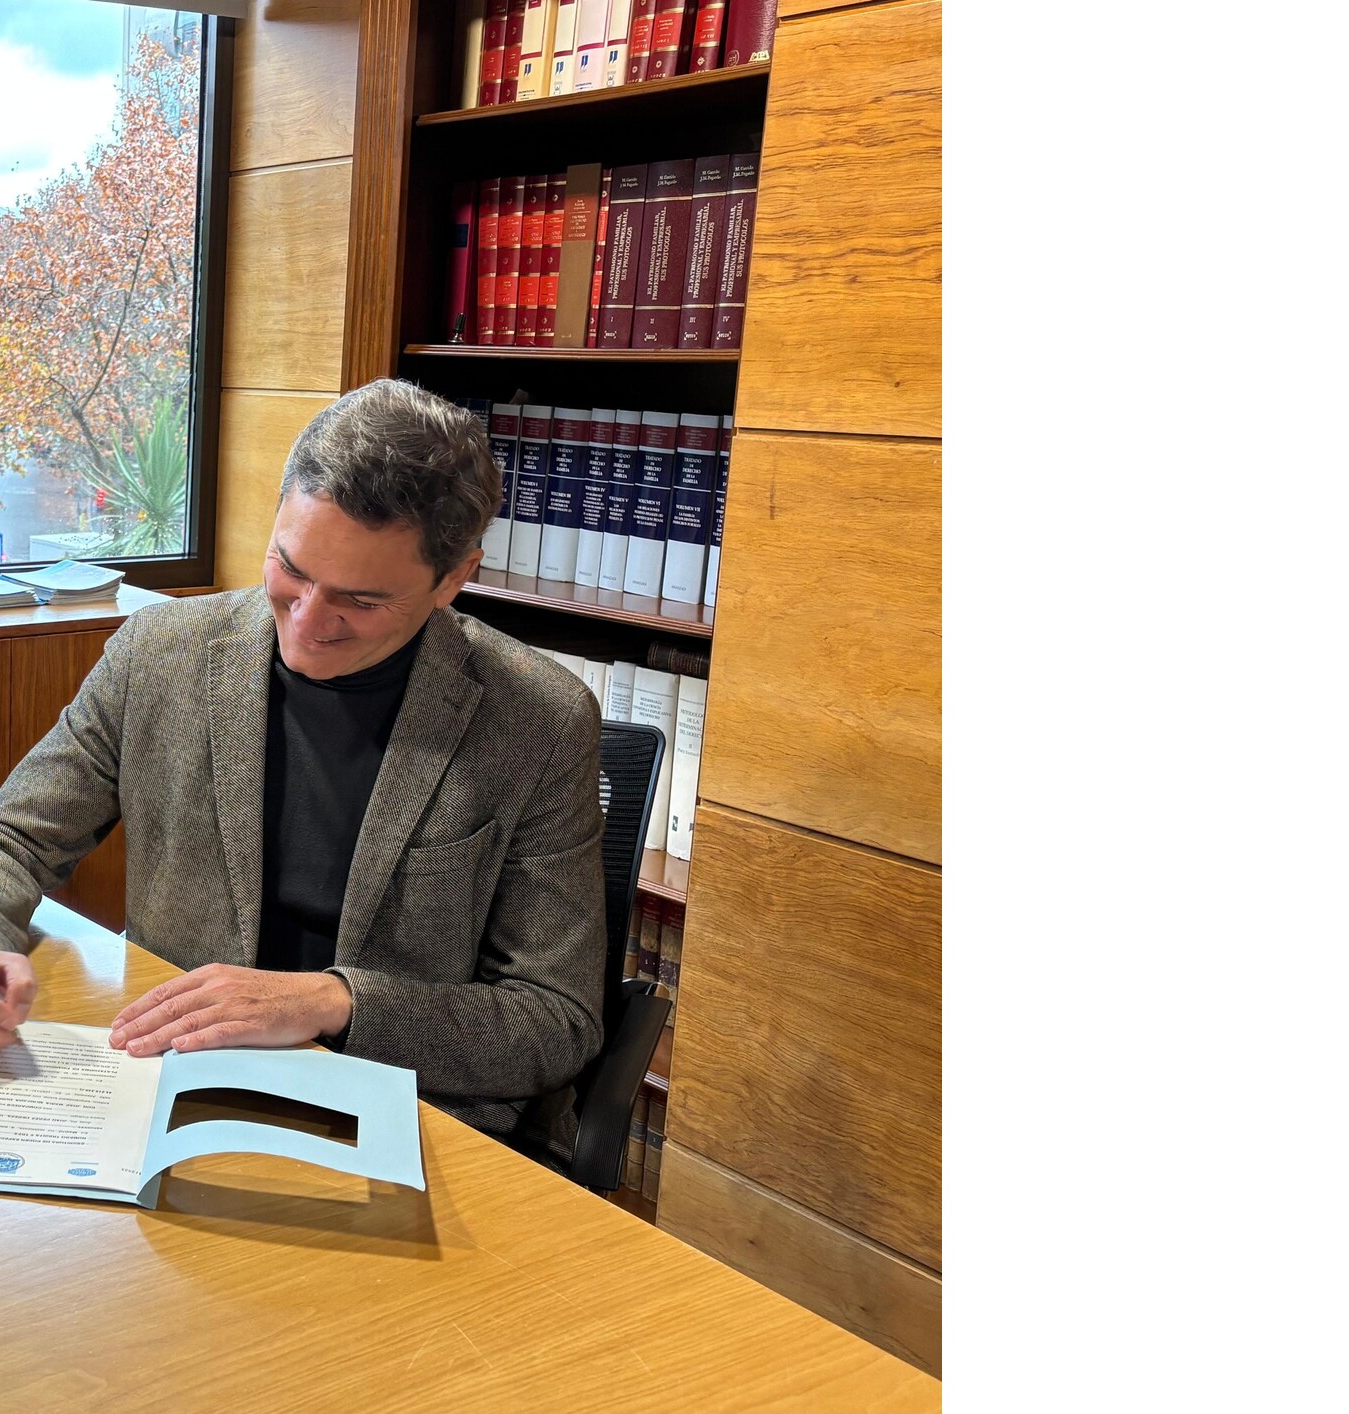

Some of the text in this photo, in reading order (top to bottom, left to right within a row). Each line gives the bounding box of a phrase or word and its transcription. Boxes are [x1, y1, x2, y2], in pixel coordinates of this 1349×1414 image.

[623, 227, 633, 268] PROTOCOLOS
[662, 226, 672, 268] PROTOCOLOS
[704, 222, 715, 265] PROTOCOLOS
[722, 240, 732, 281] PATRIMONIO
[738, 219, 749, 263] PROTOCOLOS
[609, 246, 617, 284] PATRIMONIO
[613, 258, 623, 299] PROFESIONAL
[648, 246, 657, 285] PATRIMONIO
[652, 258, 661, 300] PROFESIONAL
[689, 243, 699, 283] PATRIMONIO
[693, 255, 703, 298] PROFESIONAL
[726, 253, 737, 297] PROFESIONAL
